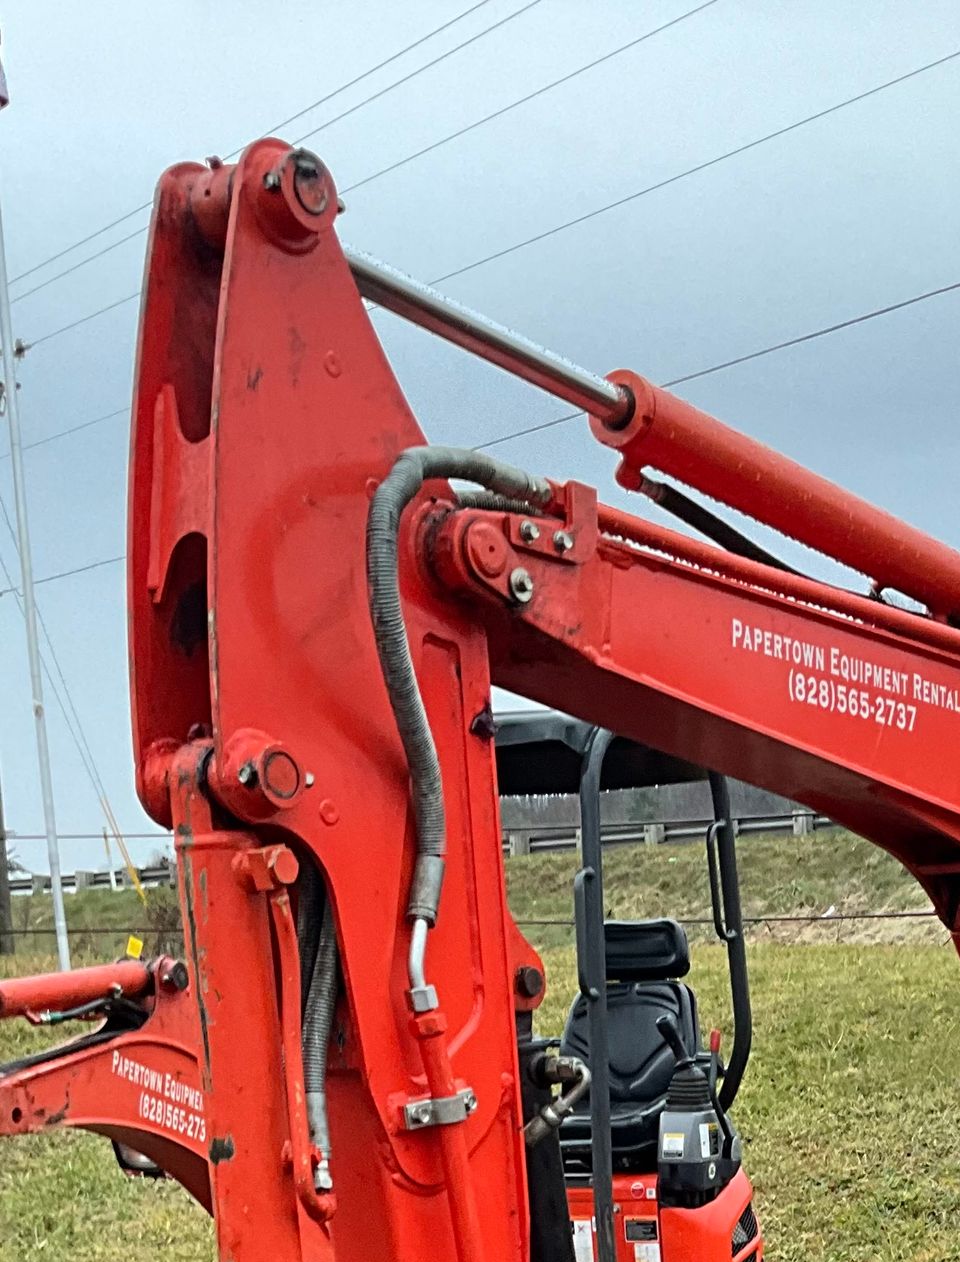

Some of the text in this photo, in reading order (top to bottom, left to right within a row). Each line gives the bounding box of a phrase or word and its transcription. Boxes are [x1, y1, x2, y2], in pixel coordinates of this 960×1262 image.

[732, 618, 825, 672] PAPERTOWN
[830, 647, 909, 697] EQUIPMENT
[788, 668, 917, 732] (828)565-2737
[111, 1049, 164, 1094] PAPERTOWN
[139, 1091, 207, 1143] (828)565-273
